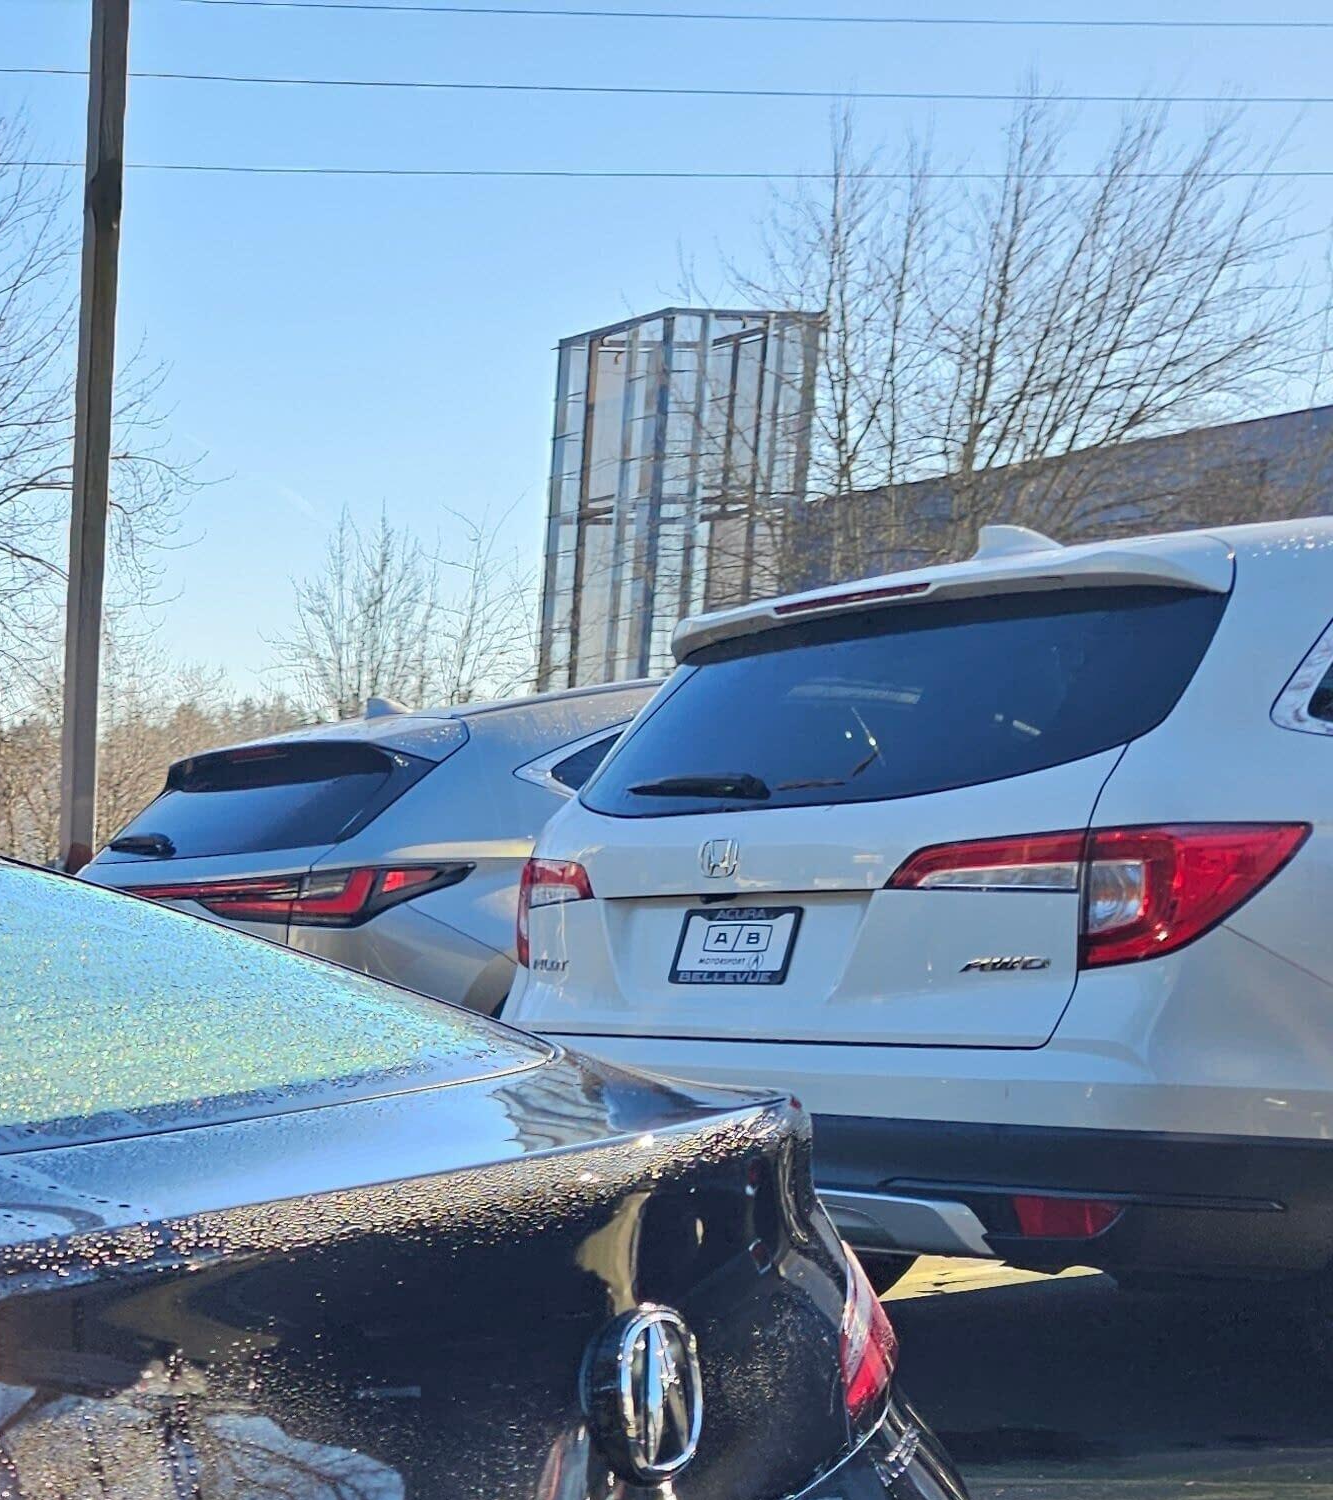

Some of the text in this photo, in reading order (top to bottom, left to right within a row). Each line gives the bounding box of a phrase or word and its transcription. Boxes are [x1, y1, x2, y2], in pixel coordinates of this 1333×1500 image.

[715, 908, 768, 920] ACURA
[713, 932, 761, 945] A B
[697, 956, 746, 966] MOTORSPORT
[958, 956, 1052, 973] AWD
[677, 971, 773, 984] BELLEVUE
